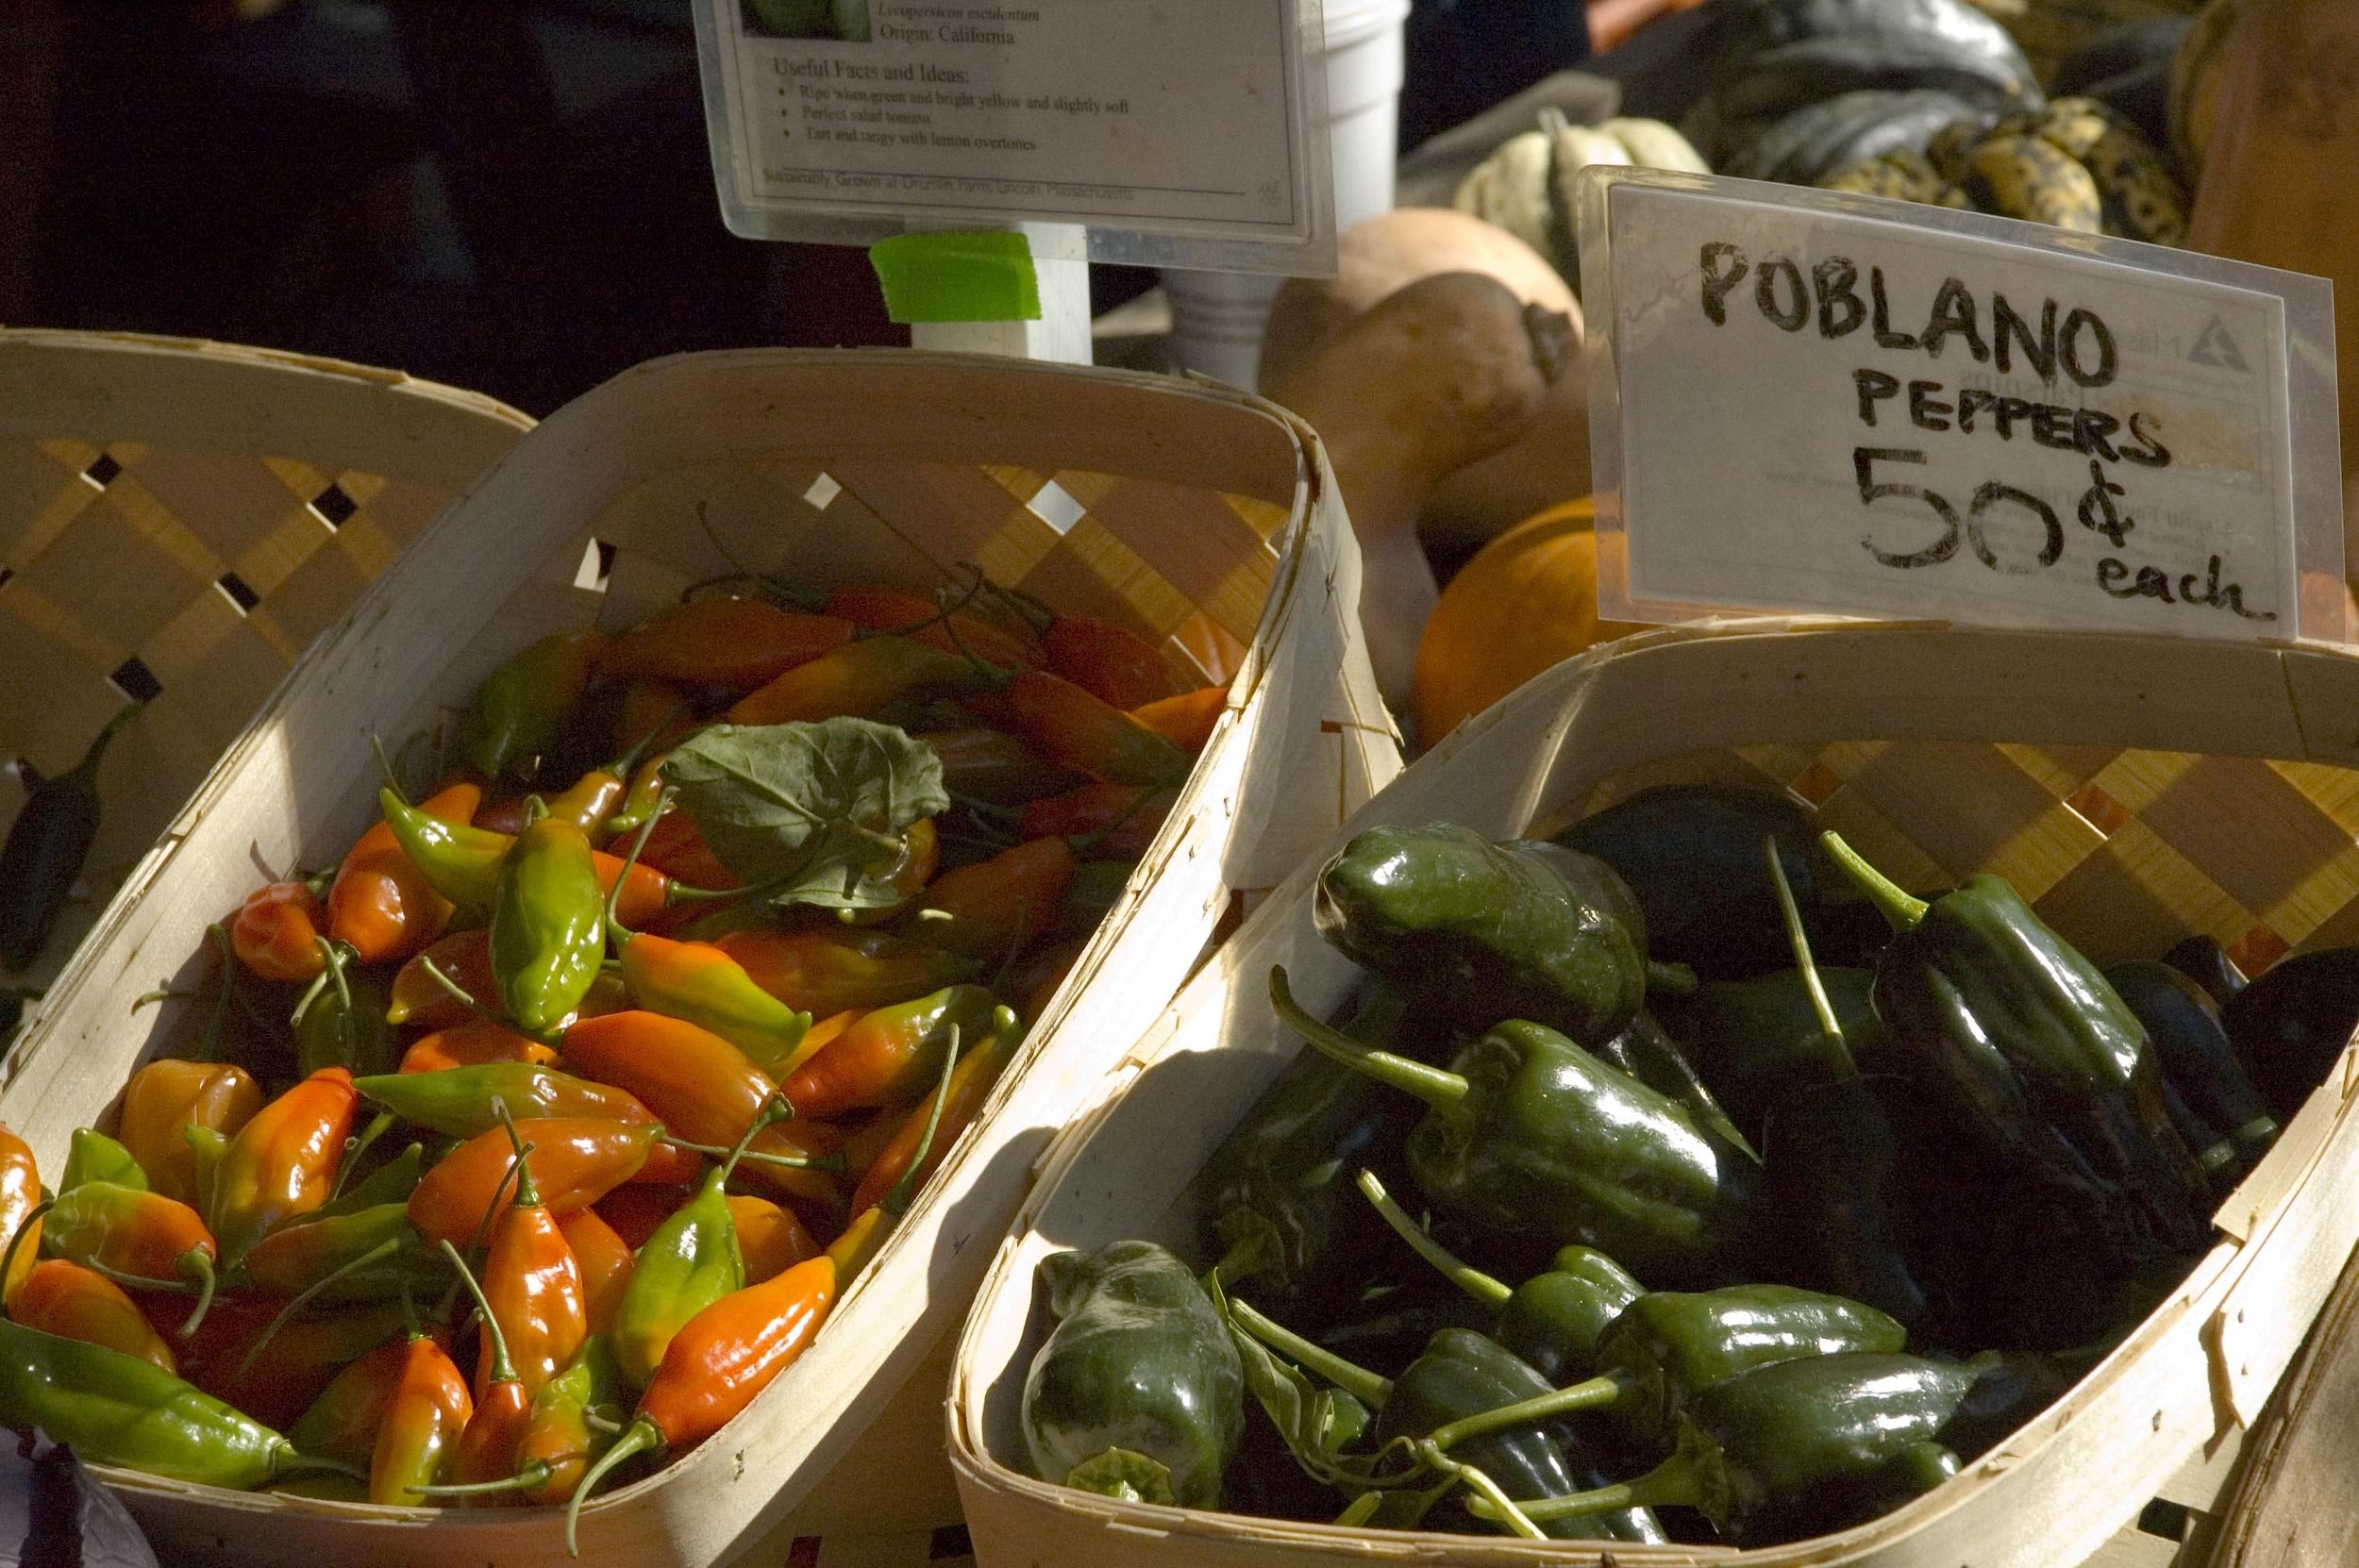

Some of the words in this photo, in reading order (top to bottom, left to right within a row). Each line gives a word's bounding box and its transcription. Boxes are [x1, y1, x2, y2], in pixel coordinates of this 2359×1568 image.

[967, 6, 1040, 22] esculentum
[879, 24, 934, 42] Origin:
[939, 25, 1014, 44] California
[774, 58, 828, 77] Useful
[835, 60, 878, 79] Facts
[884, 63, 914, 81] and
[920, 65, 968, 83] Ideas:
[800, 85, 830, 102] Ripe
[870, 92, 905, 106] green
[910, 91, 933, 104] and
[935, 91, 974, 108] bright
[978, 93, 1020, 110] yellow
[1027, 97, 1050, 110] and
[1053, 97, 1100, 114] slightly
[1105, 99, 1129, 113] soft
[802, 106, 847, 122] Perfect
[849, 108, 882, 124] salad
[886, 111, 930, 125] tomato
[806, 126, 830, 142] Tart
[835, 128, 857, 142] and
[861, 131, 895, 146] tangy
[899, 131, 928, 145] with
[931, 132, 971, 148] lemon
[974, 137, 1036, 151] overtones
[836, 171, 881, 187] Grown
[1698, 242, 2119, 388] POBLANO
[1852, 369, 2173, 470] PEPPERS
[2095, 554, 2277, 623] each
